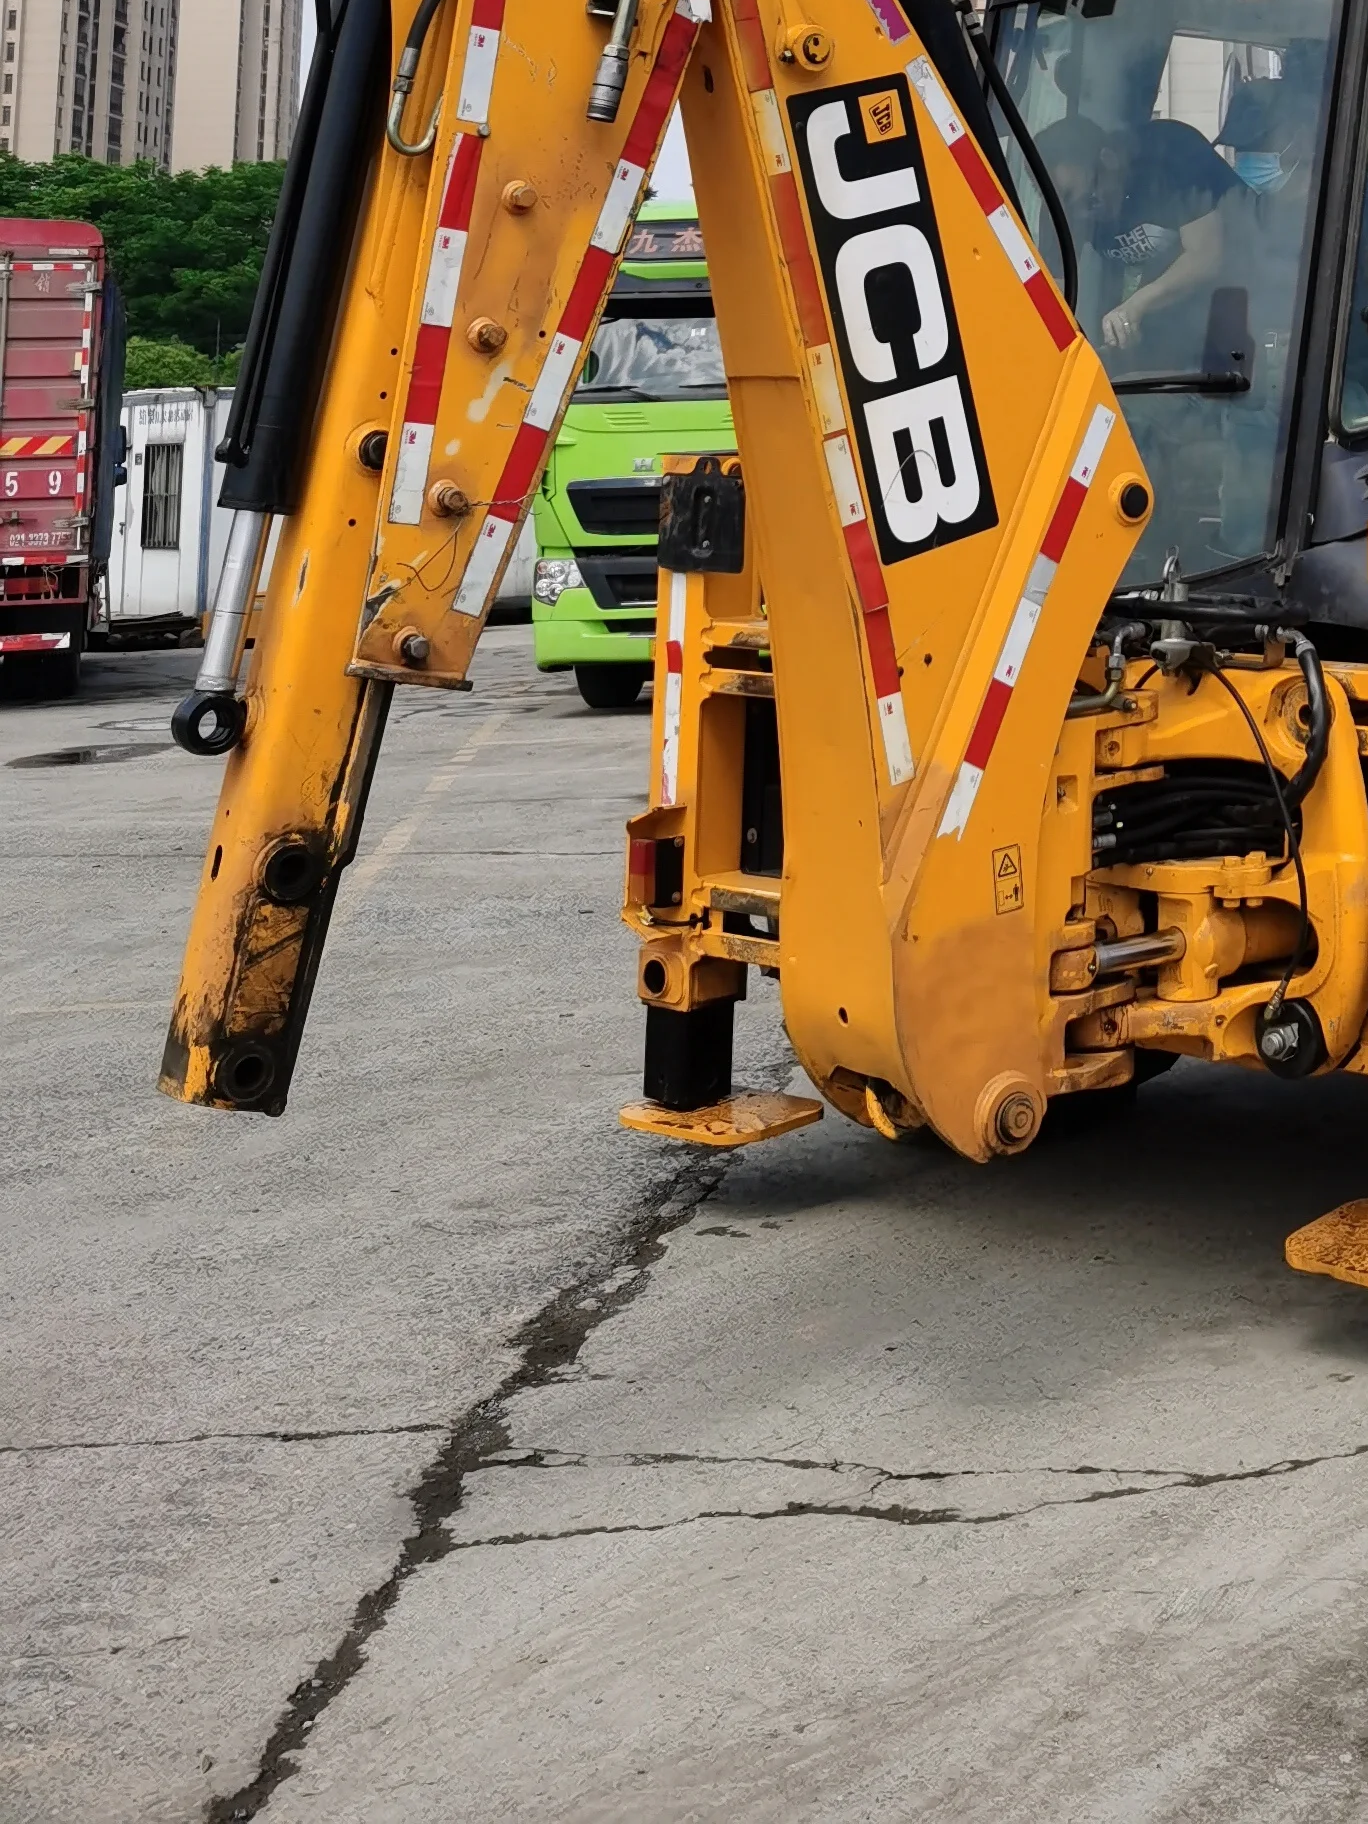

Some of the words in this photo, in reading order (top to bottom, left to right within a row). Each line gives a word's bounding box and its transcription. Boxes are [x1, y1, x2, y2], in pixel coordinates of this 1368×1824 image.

[477, 34, 486, 48] 3M
[871, 102, 892, 133] JCB
[442, 235, 451, 250] 3M
[1114, 225, 1147, 247] THE
[806, 100, 981, 543] JCB
[408, 430, 417, 445] 3M
[486, 523, 497, 538] 3M
